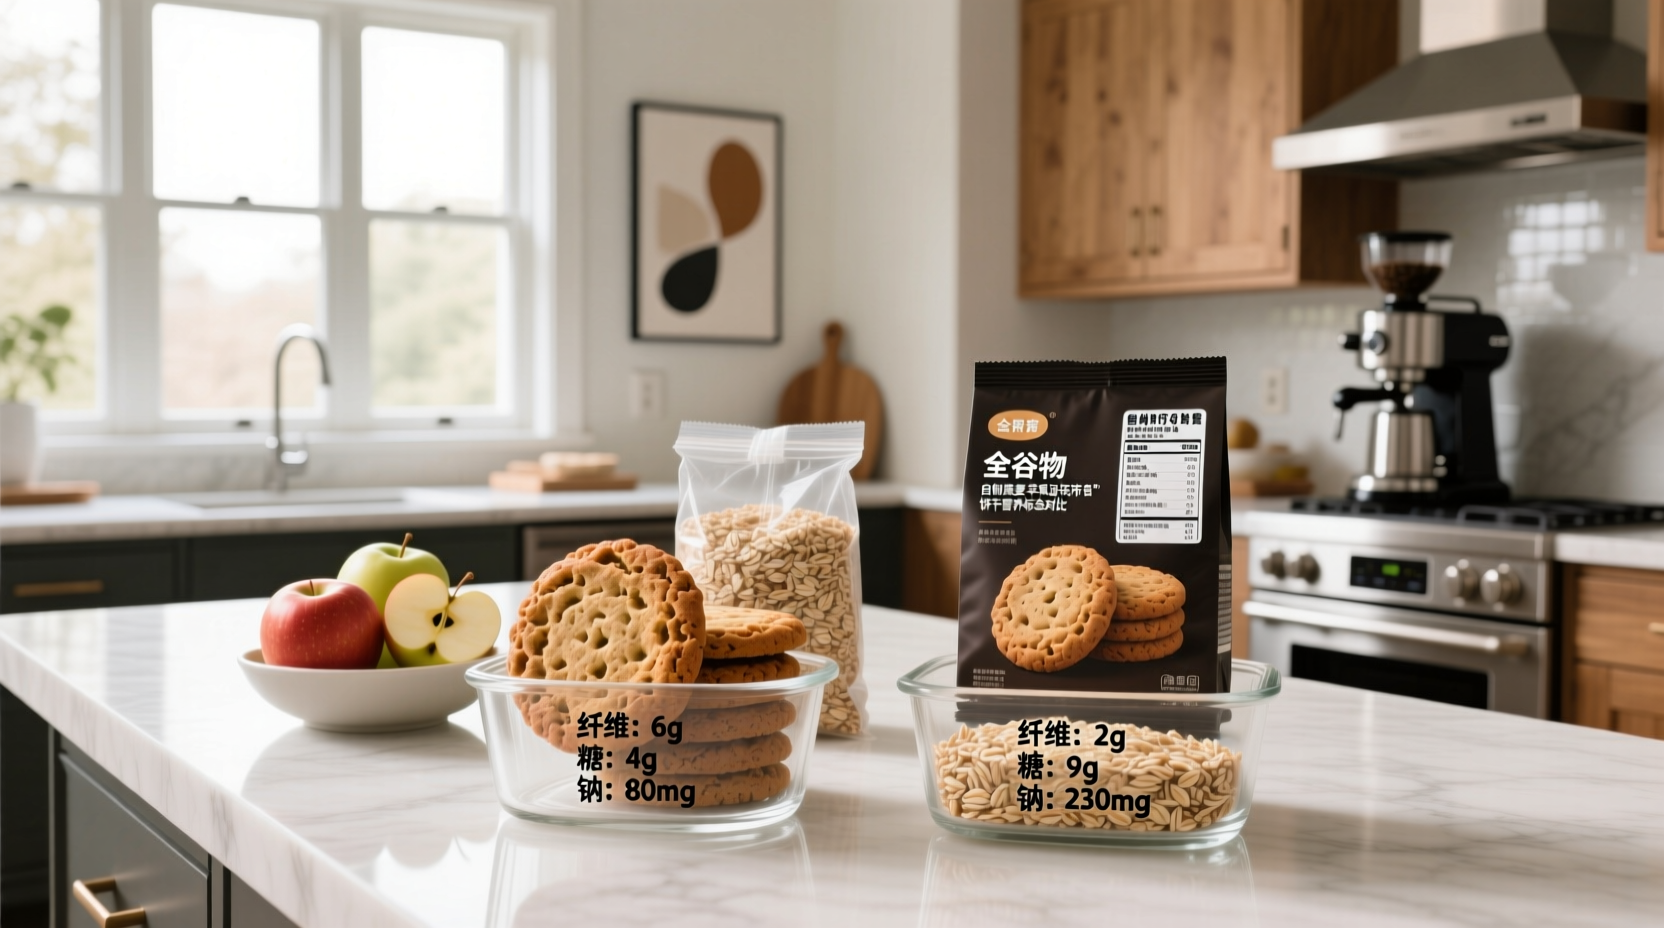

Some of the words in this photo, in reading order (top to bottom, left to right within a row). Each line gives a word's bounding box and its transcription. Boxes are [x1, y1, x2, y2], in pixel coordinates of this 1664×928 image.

[983, 450, 1067, 480] 全谷物
[651, 715, 683, 745] 6g
[1094, 724, 1126, 753] 2g
[625, 746, 657, 776] 4g
[1066, 755, 1099, 785] 9g
[625, 778, 696, 808] 80mg
[1064, 787, 1151, 818] 230mg
